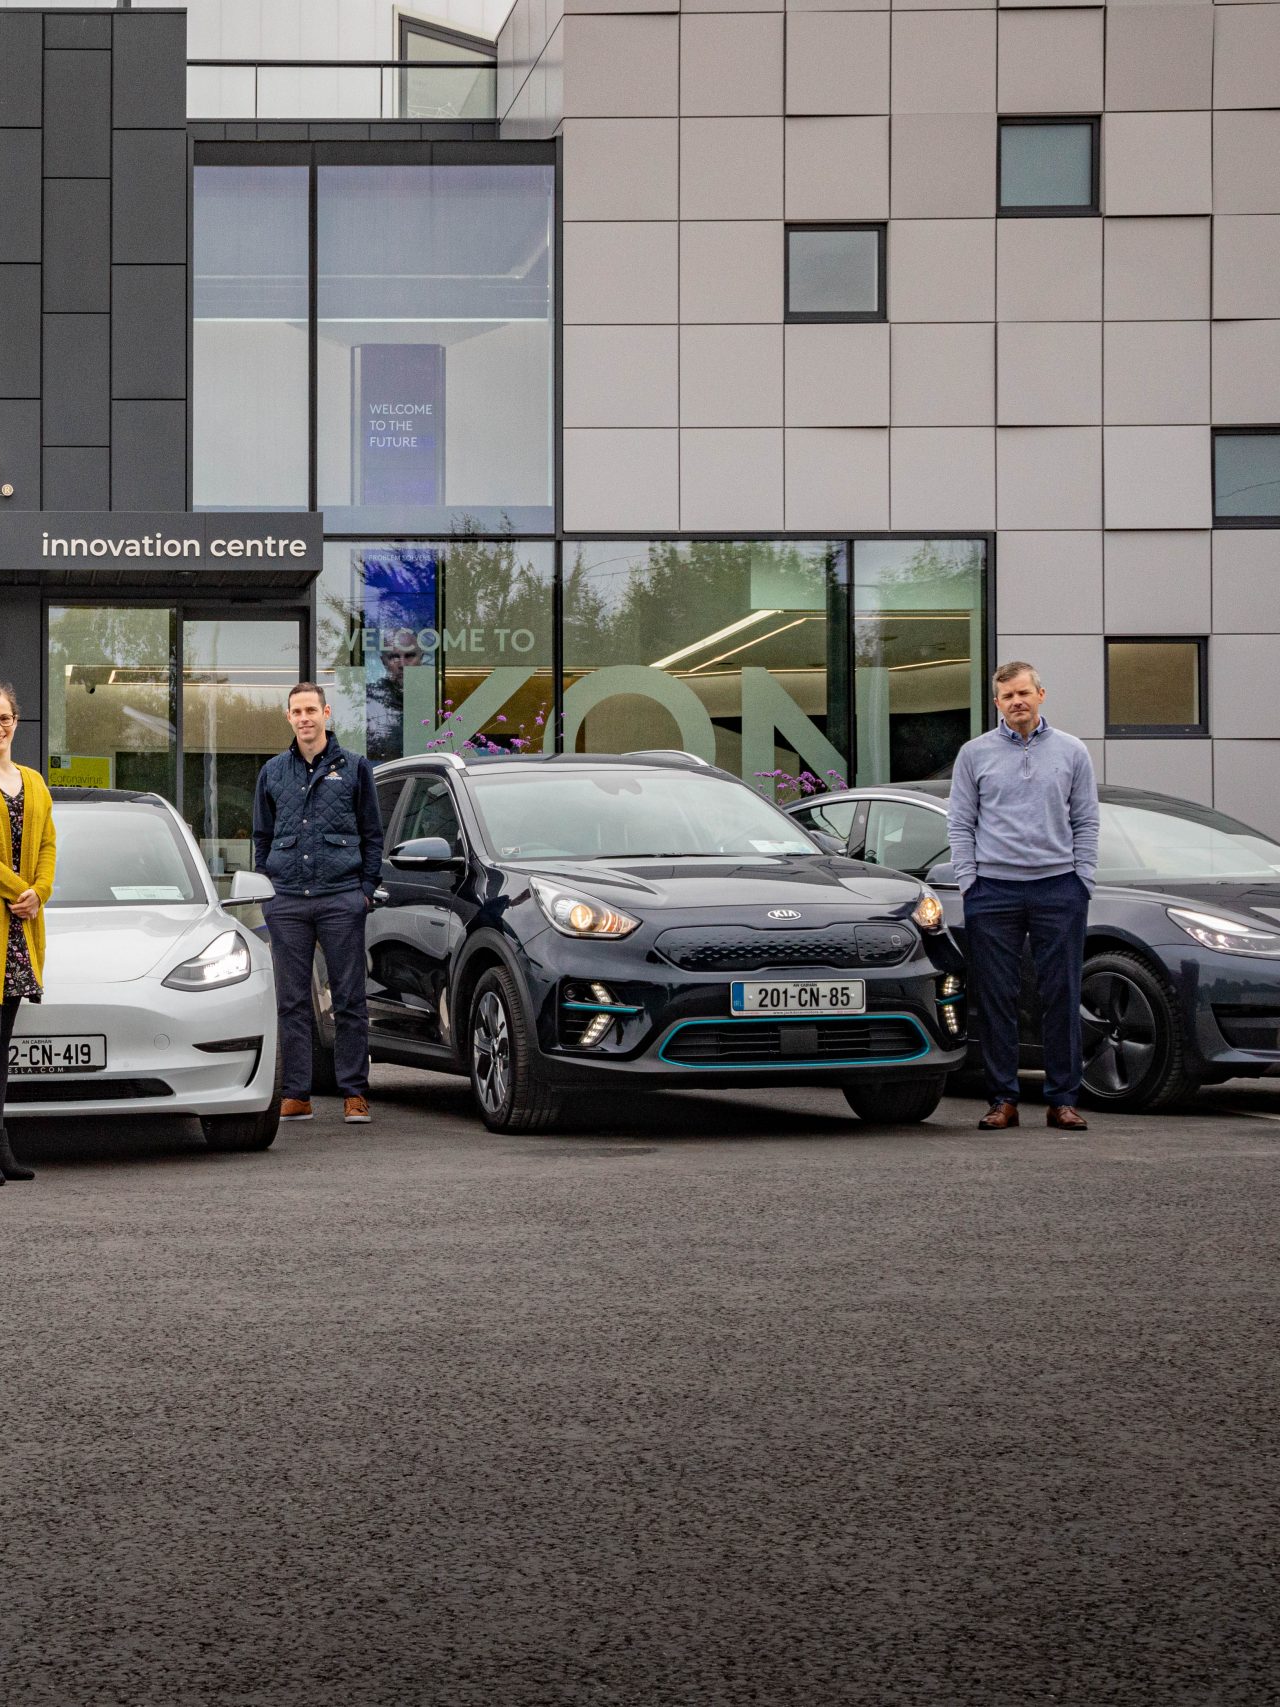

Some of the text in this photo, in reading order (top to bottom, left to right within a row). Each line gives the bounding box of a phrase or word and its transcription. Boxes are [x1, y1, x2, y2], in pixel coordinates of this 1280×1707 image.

[370, 403, 433, 416] WELCOME
[369, 420, 413, 431] TO THE
[369, 436, 418, 448] FUTURE
[41, 531, 308, 557] innovation centre
[494, 628, 535, 652] TO
[49, 774, 104, 785] Coronavirus
[771, 909, 800, 918] KIA
[758, 986, 851, 1008] 201-CN-85
[8, 1043, 92, 1066] 2-CN-419
[7, 1066, 65, 1074] ESLA.COM
